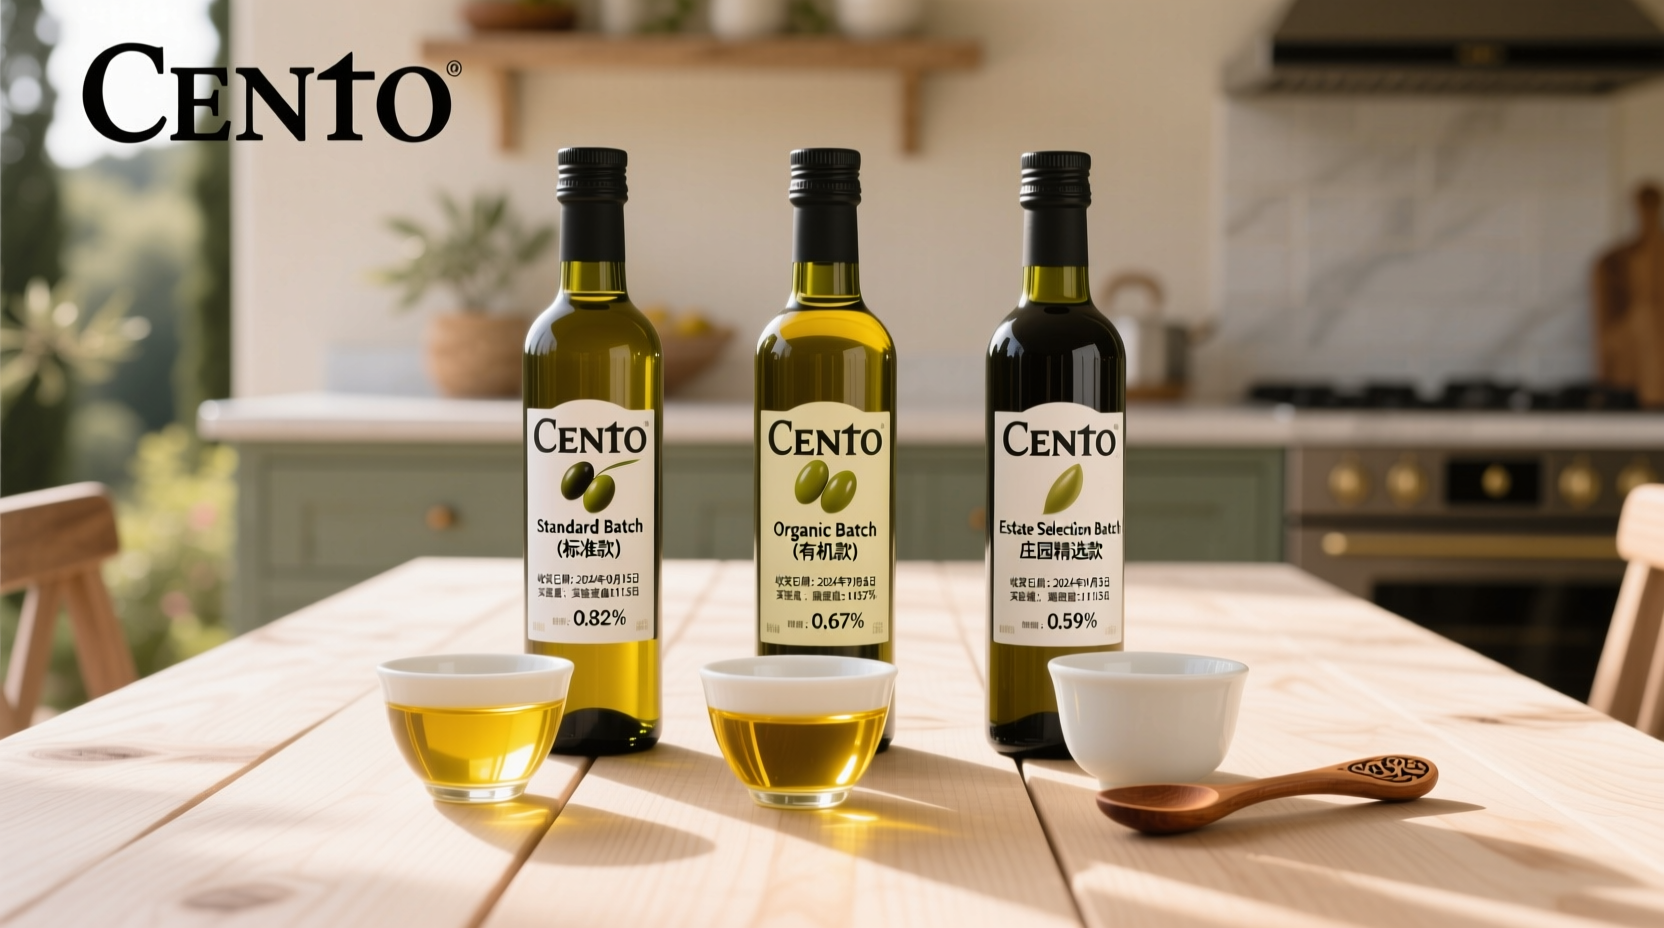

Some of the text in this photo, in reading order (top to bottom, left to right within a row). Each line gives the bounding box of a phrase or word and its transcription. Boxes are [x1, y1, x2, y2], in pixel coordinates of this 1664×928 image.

[537, 518, 643, 534] Standard Batch
[774, 521, 877, 542] Organic Batch
[999, 520, 1034, 535] Estate
[1037, 520, 1091, 536] Selection
[1020, 541, 1103, 561] 庄园精选款
[573, 608, 627, 626] 0.82%
[811, 612, 864, 630] 0.67%
[1047, 612, 1098, 630] 0.59%
